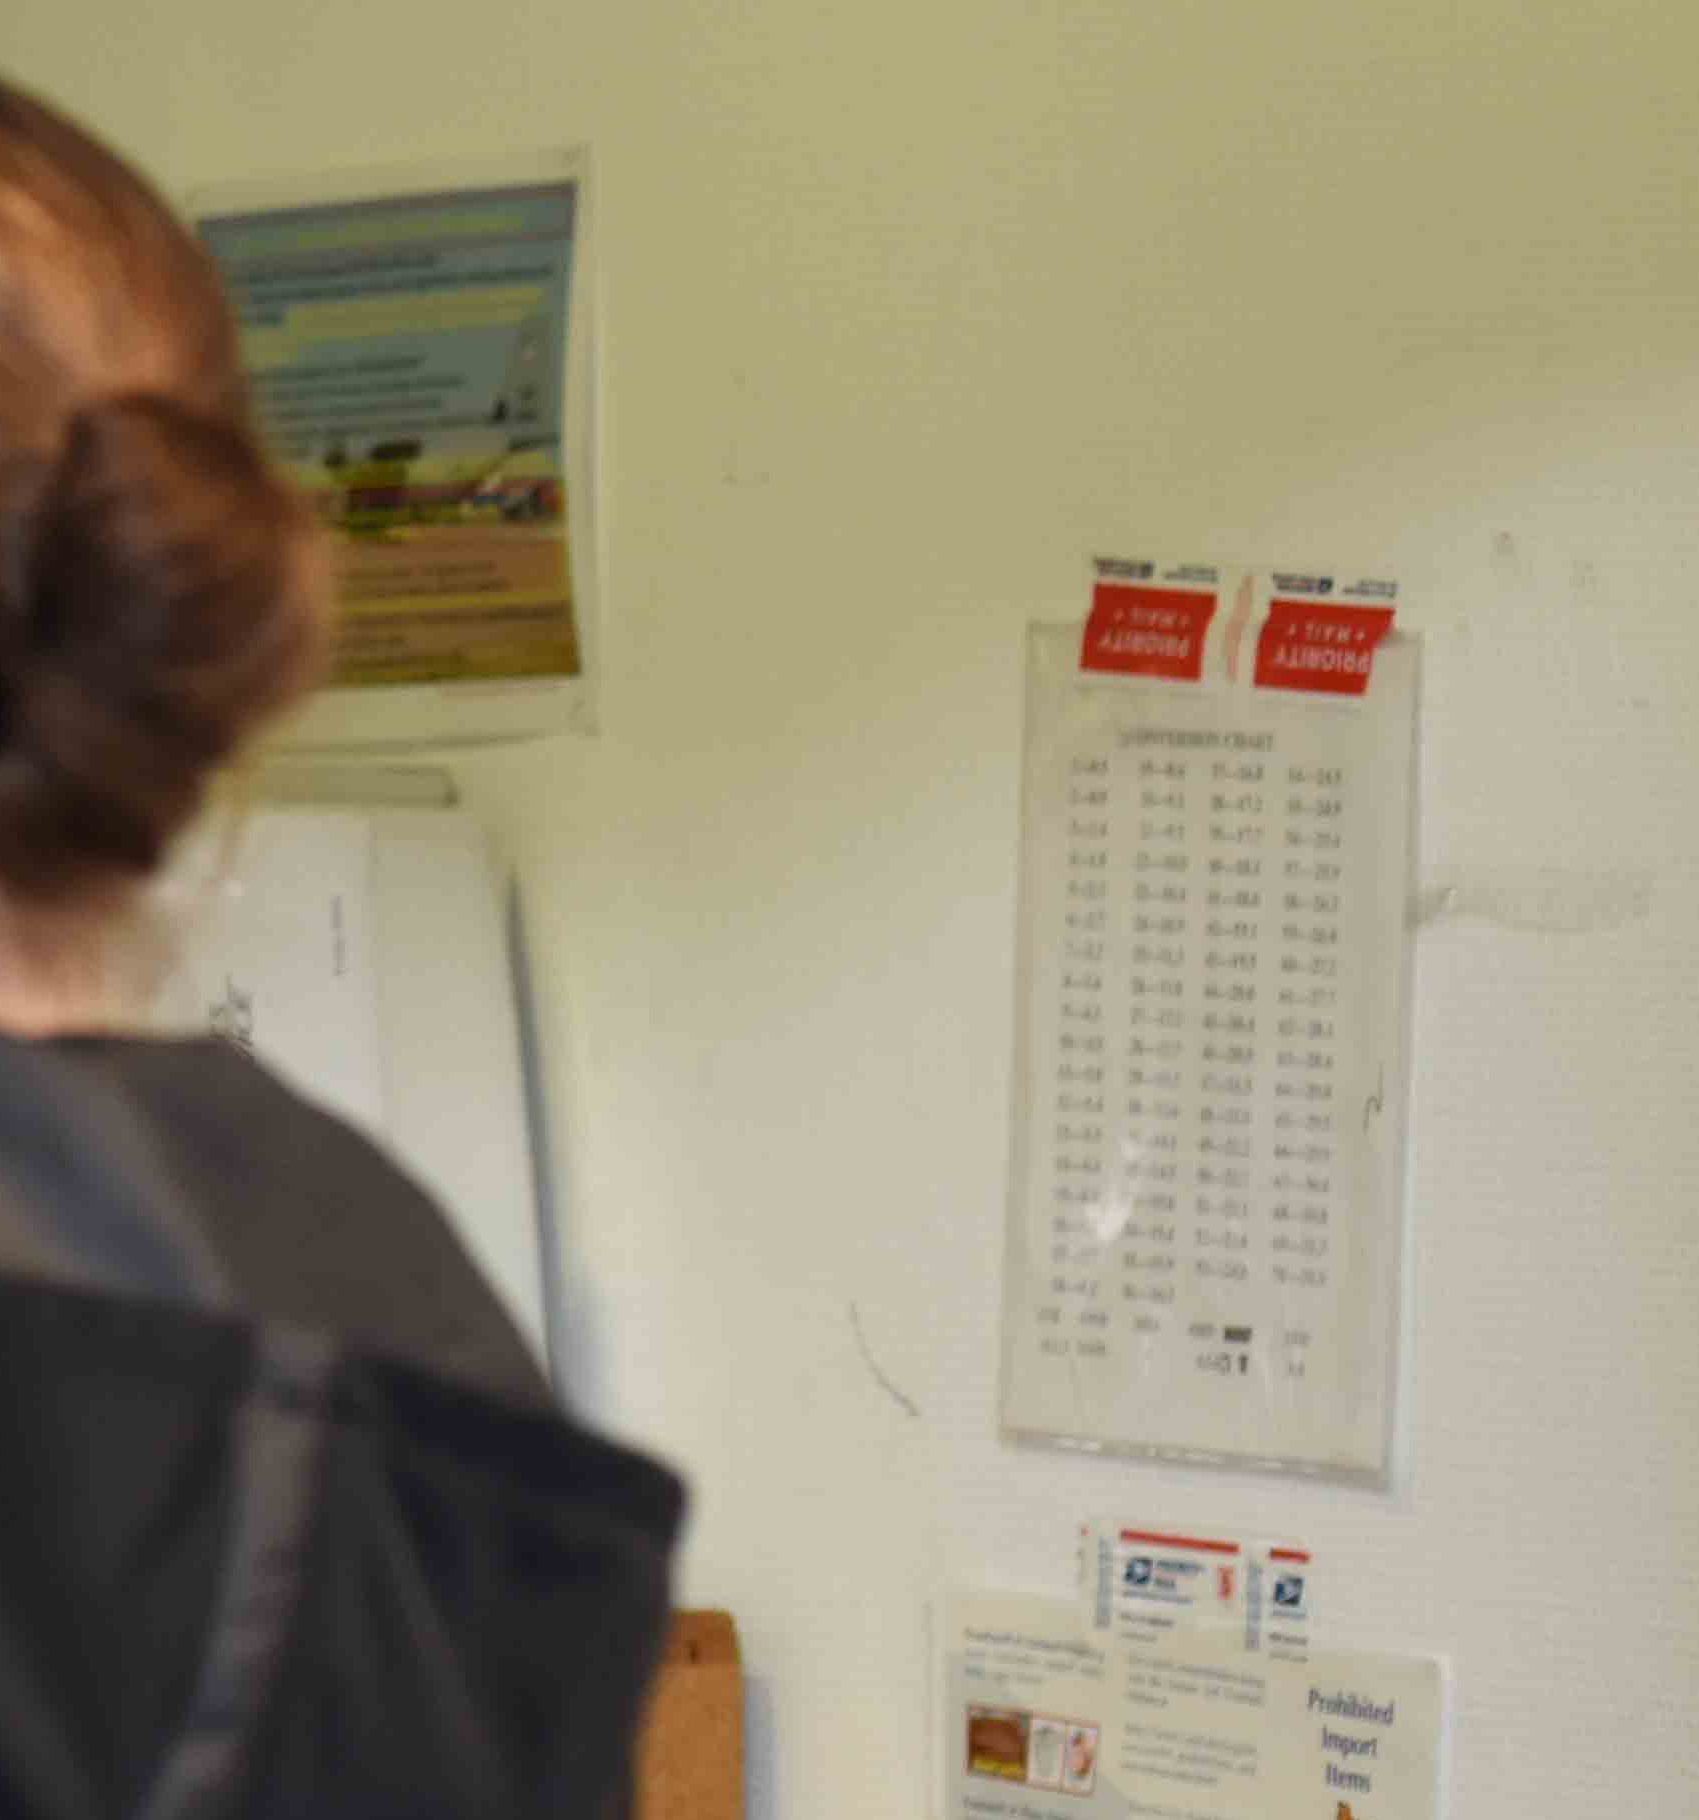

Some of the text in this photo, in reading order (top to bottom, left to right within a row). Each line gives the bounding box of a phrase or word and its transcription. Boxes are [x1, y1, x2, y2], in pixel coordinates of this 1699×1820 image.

[1307, 1687, 1394, 1727] Prohibited
[1322, 1723, 1378, 1760] Import
[1325, 1762, 1371, 1794] Items
